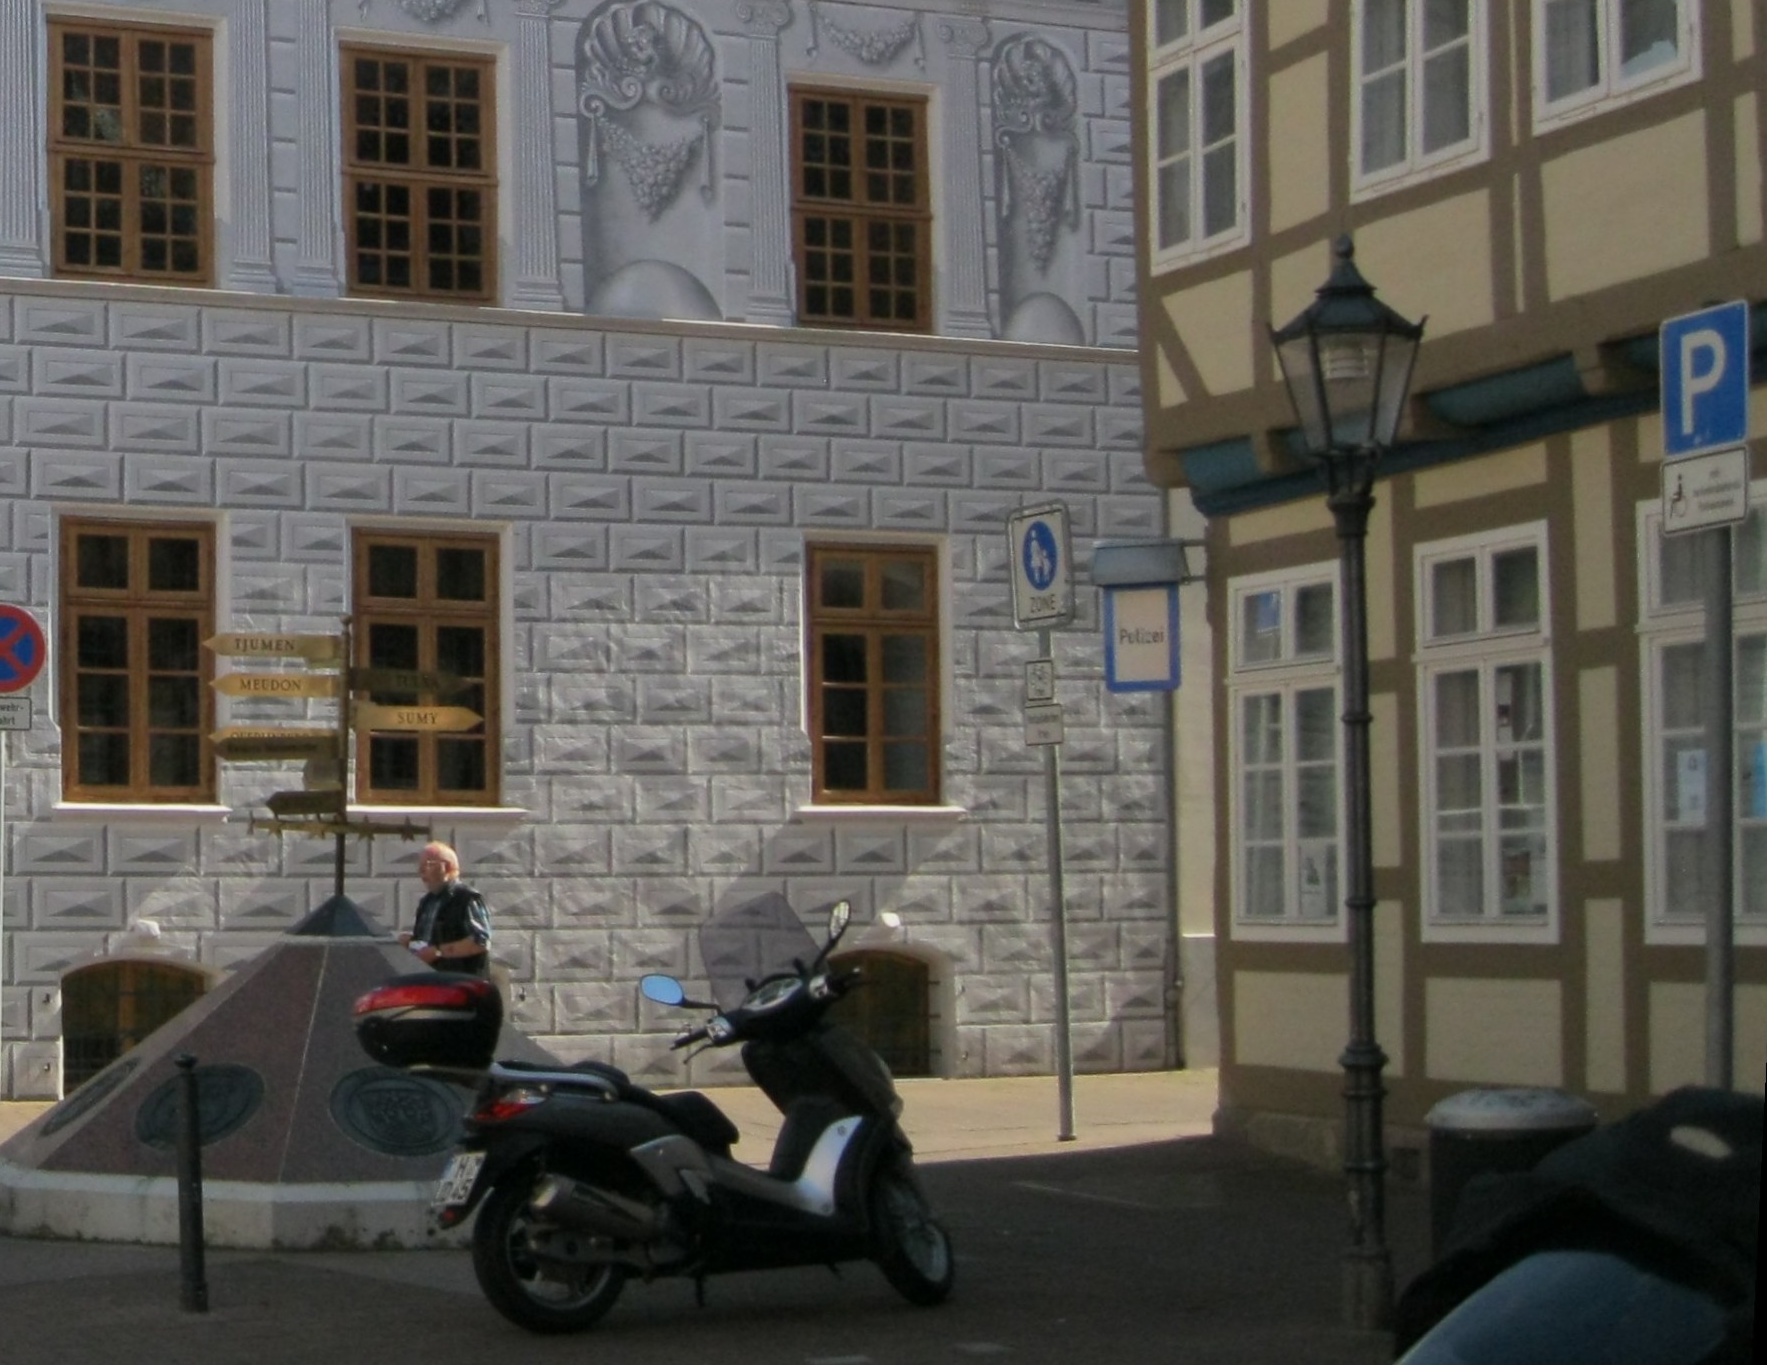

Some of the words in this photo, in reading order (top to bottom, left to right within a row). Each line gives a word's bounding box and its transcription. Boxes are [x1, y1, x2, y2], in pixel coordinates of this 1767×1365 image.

[1682, 329, 1726, 435] P
[1030, 593, 1056, 613] ZONE
[1119, 627, 1165, 645] Polizei
[235, 638, 296, 651] TJUMEN
[240, 678, 302, 691] MEUDON
[397, 712, 439, 725] SUMY
